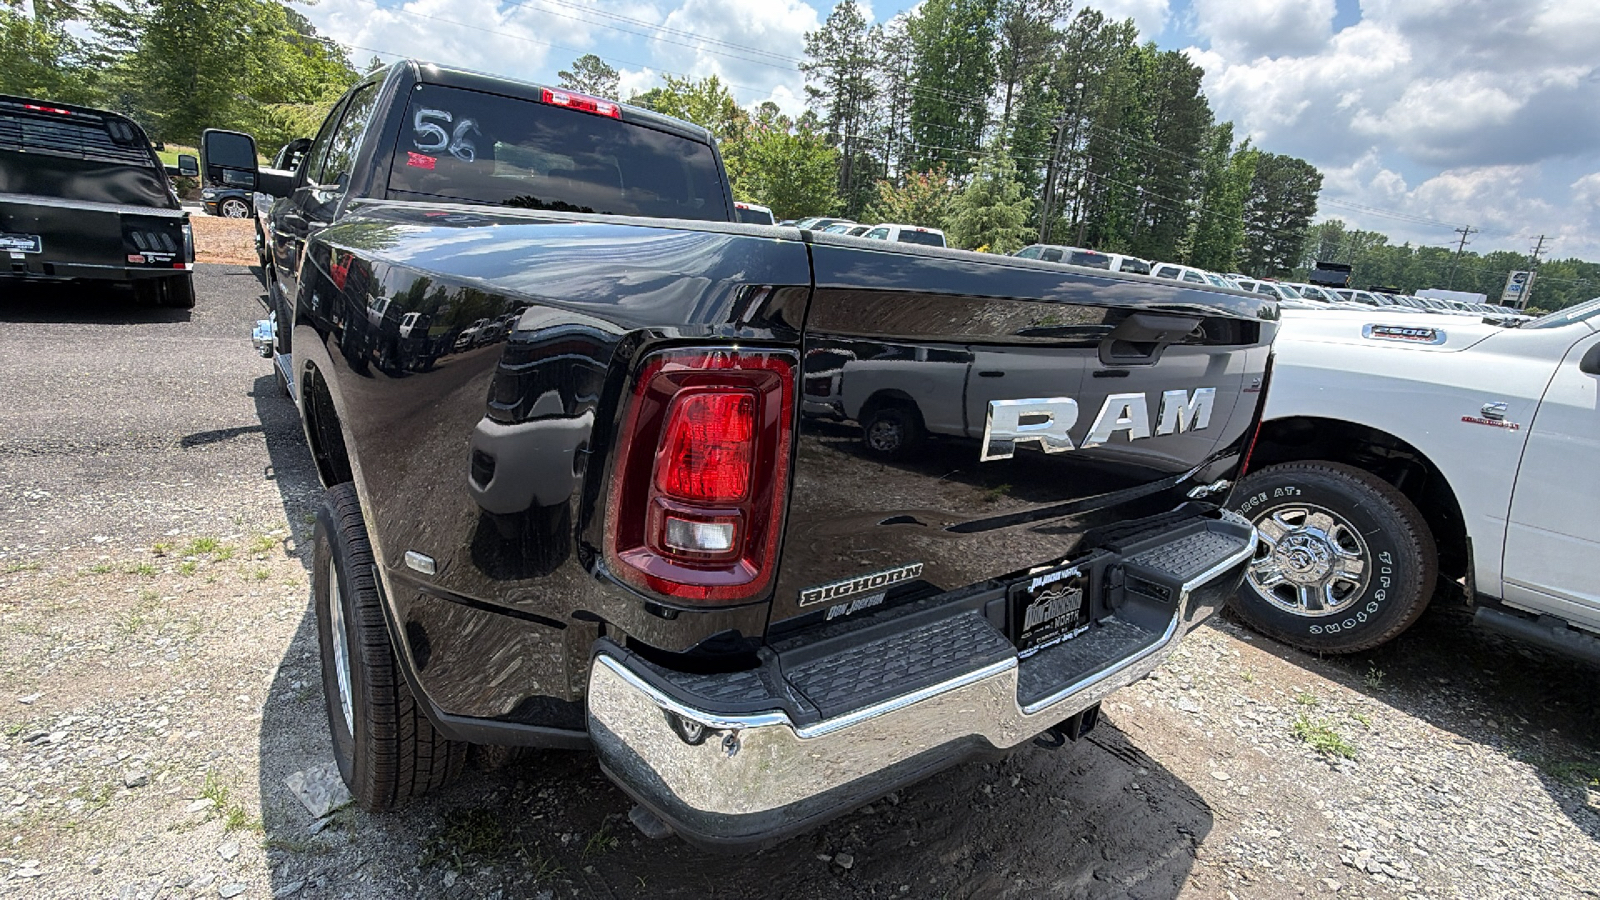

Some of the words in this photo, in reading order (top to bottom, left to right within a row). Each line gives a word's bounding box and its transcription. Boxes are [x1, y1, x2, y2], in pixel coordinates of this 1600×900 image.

[1374, 326, 1432, 337] 2500
[980, 387, 1217, 463] RAM
[1054, 610, 1080, 629] NORTH
